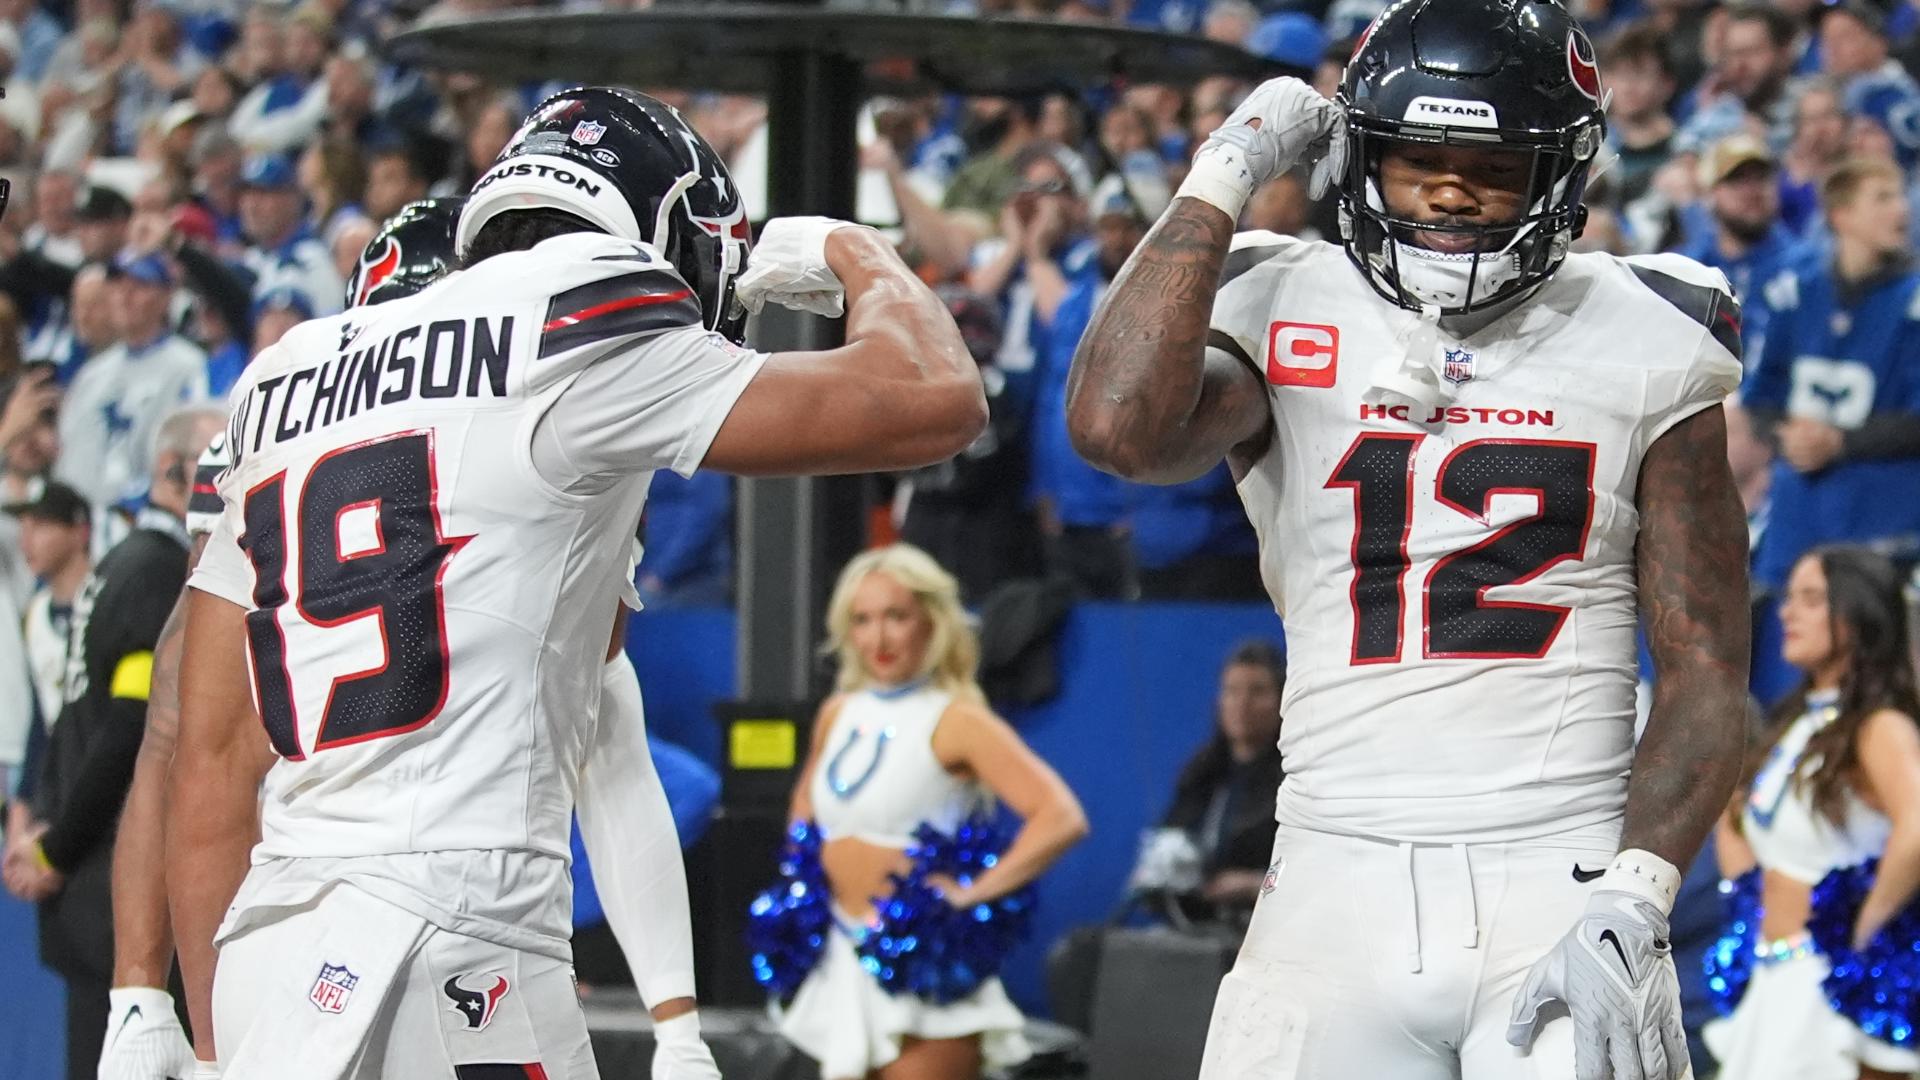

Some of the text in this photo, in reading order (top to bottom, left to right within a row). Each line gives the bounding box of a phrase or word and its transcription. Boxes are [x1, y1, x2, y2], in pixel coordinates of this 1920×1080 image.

[1418, 103, 1490, 118] TEXANS
[575, 129, 600, 142] NFL
[1275, 326, 1333, 370] C
[1447, 362, 1472, 379] NFL
[1359, 403, 1554, 426] HOUSTON
[1323, 431, 1597, 666] 12
[237, 427, 480, 763] 19
[312, 980, 345, 1011] NFL
